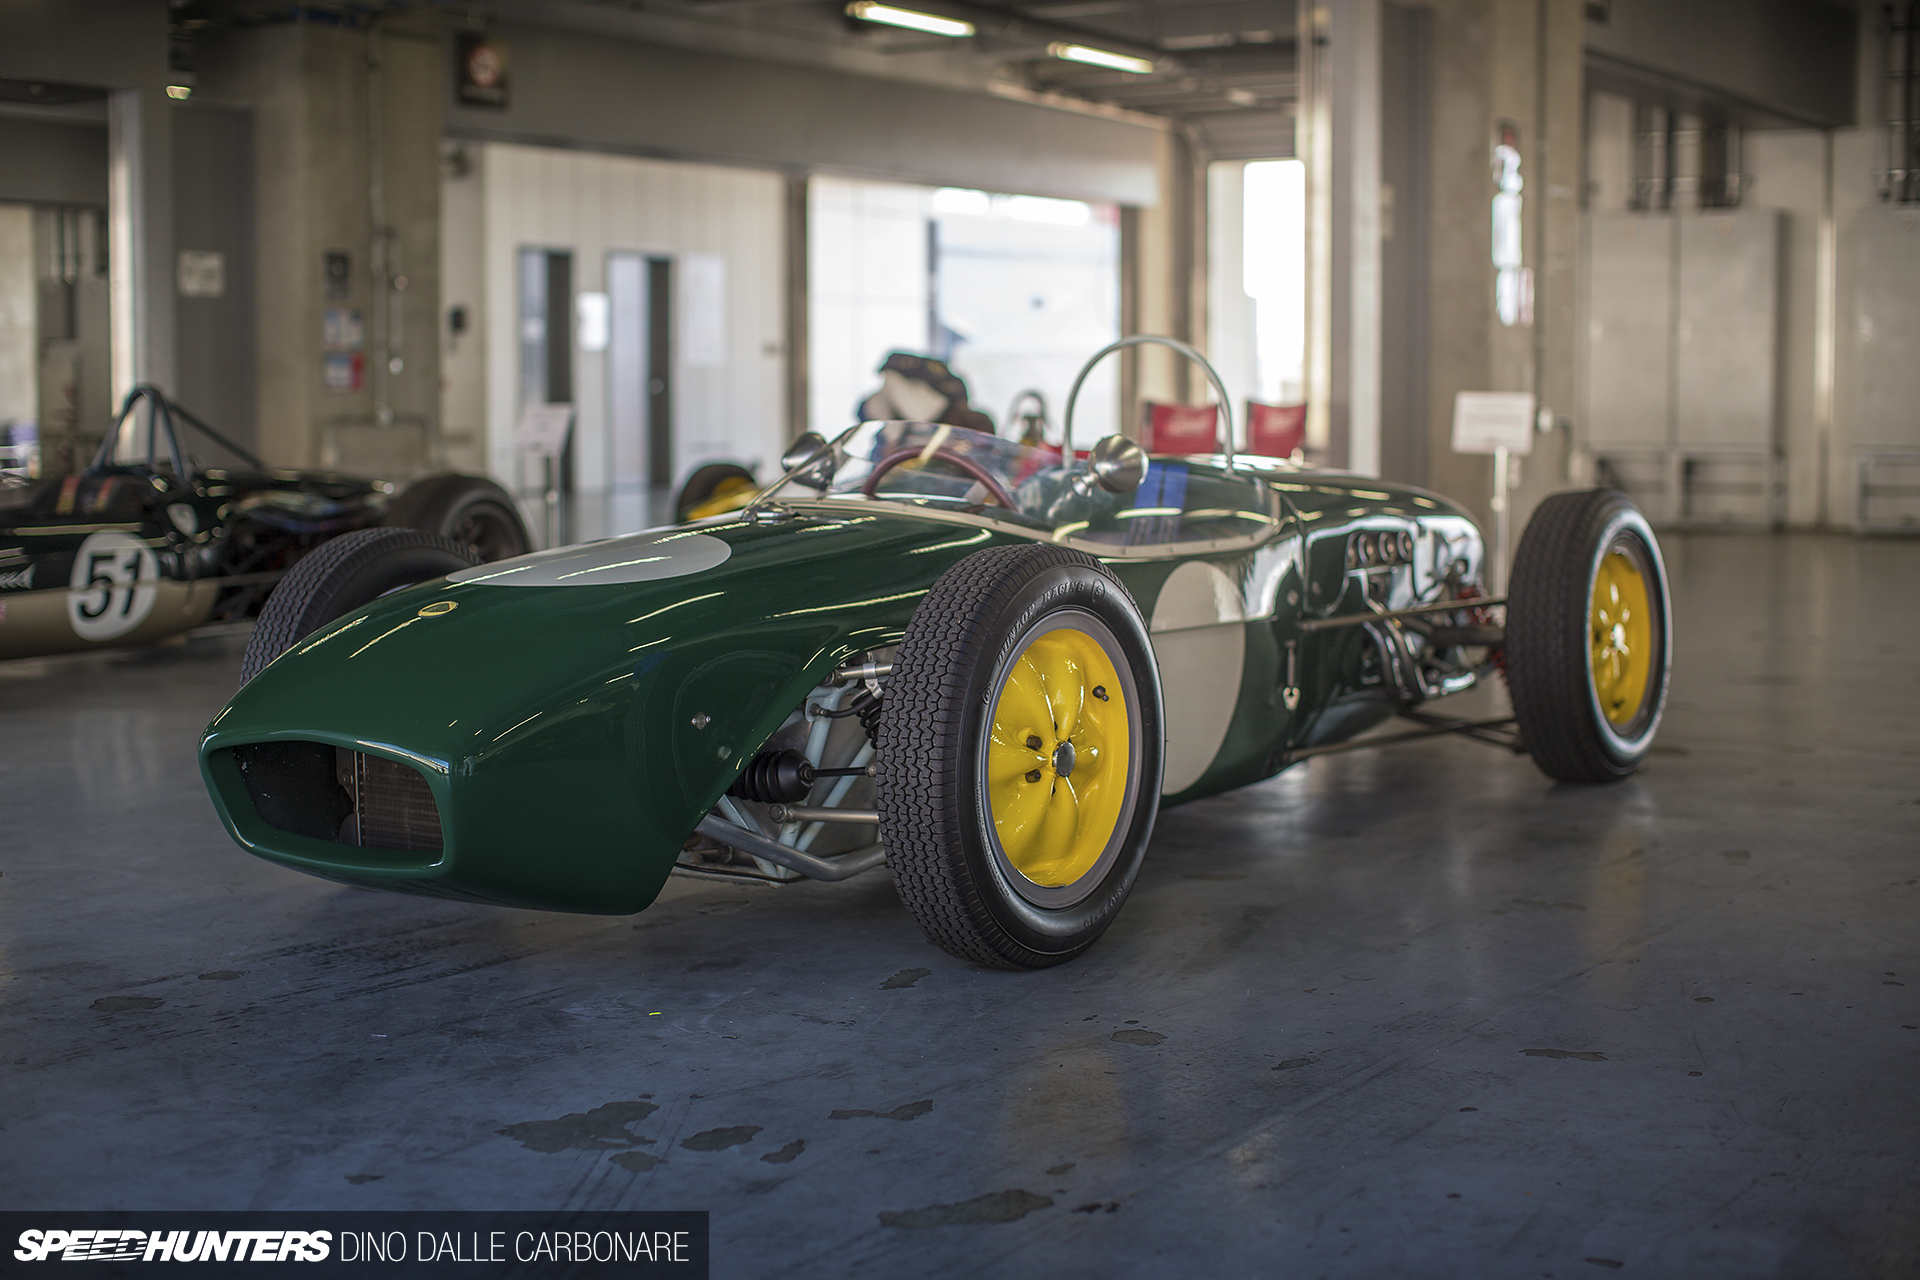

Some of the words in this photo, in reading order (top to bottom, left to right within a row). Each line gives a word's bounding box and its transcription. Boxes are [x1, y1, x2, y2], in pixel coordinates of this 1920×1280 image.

[79, 552, 142, 617] 51
[996, 602, 1036, 667] DUNLOP
[1042, 580, 1086, 604] RACING
